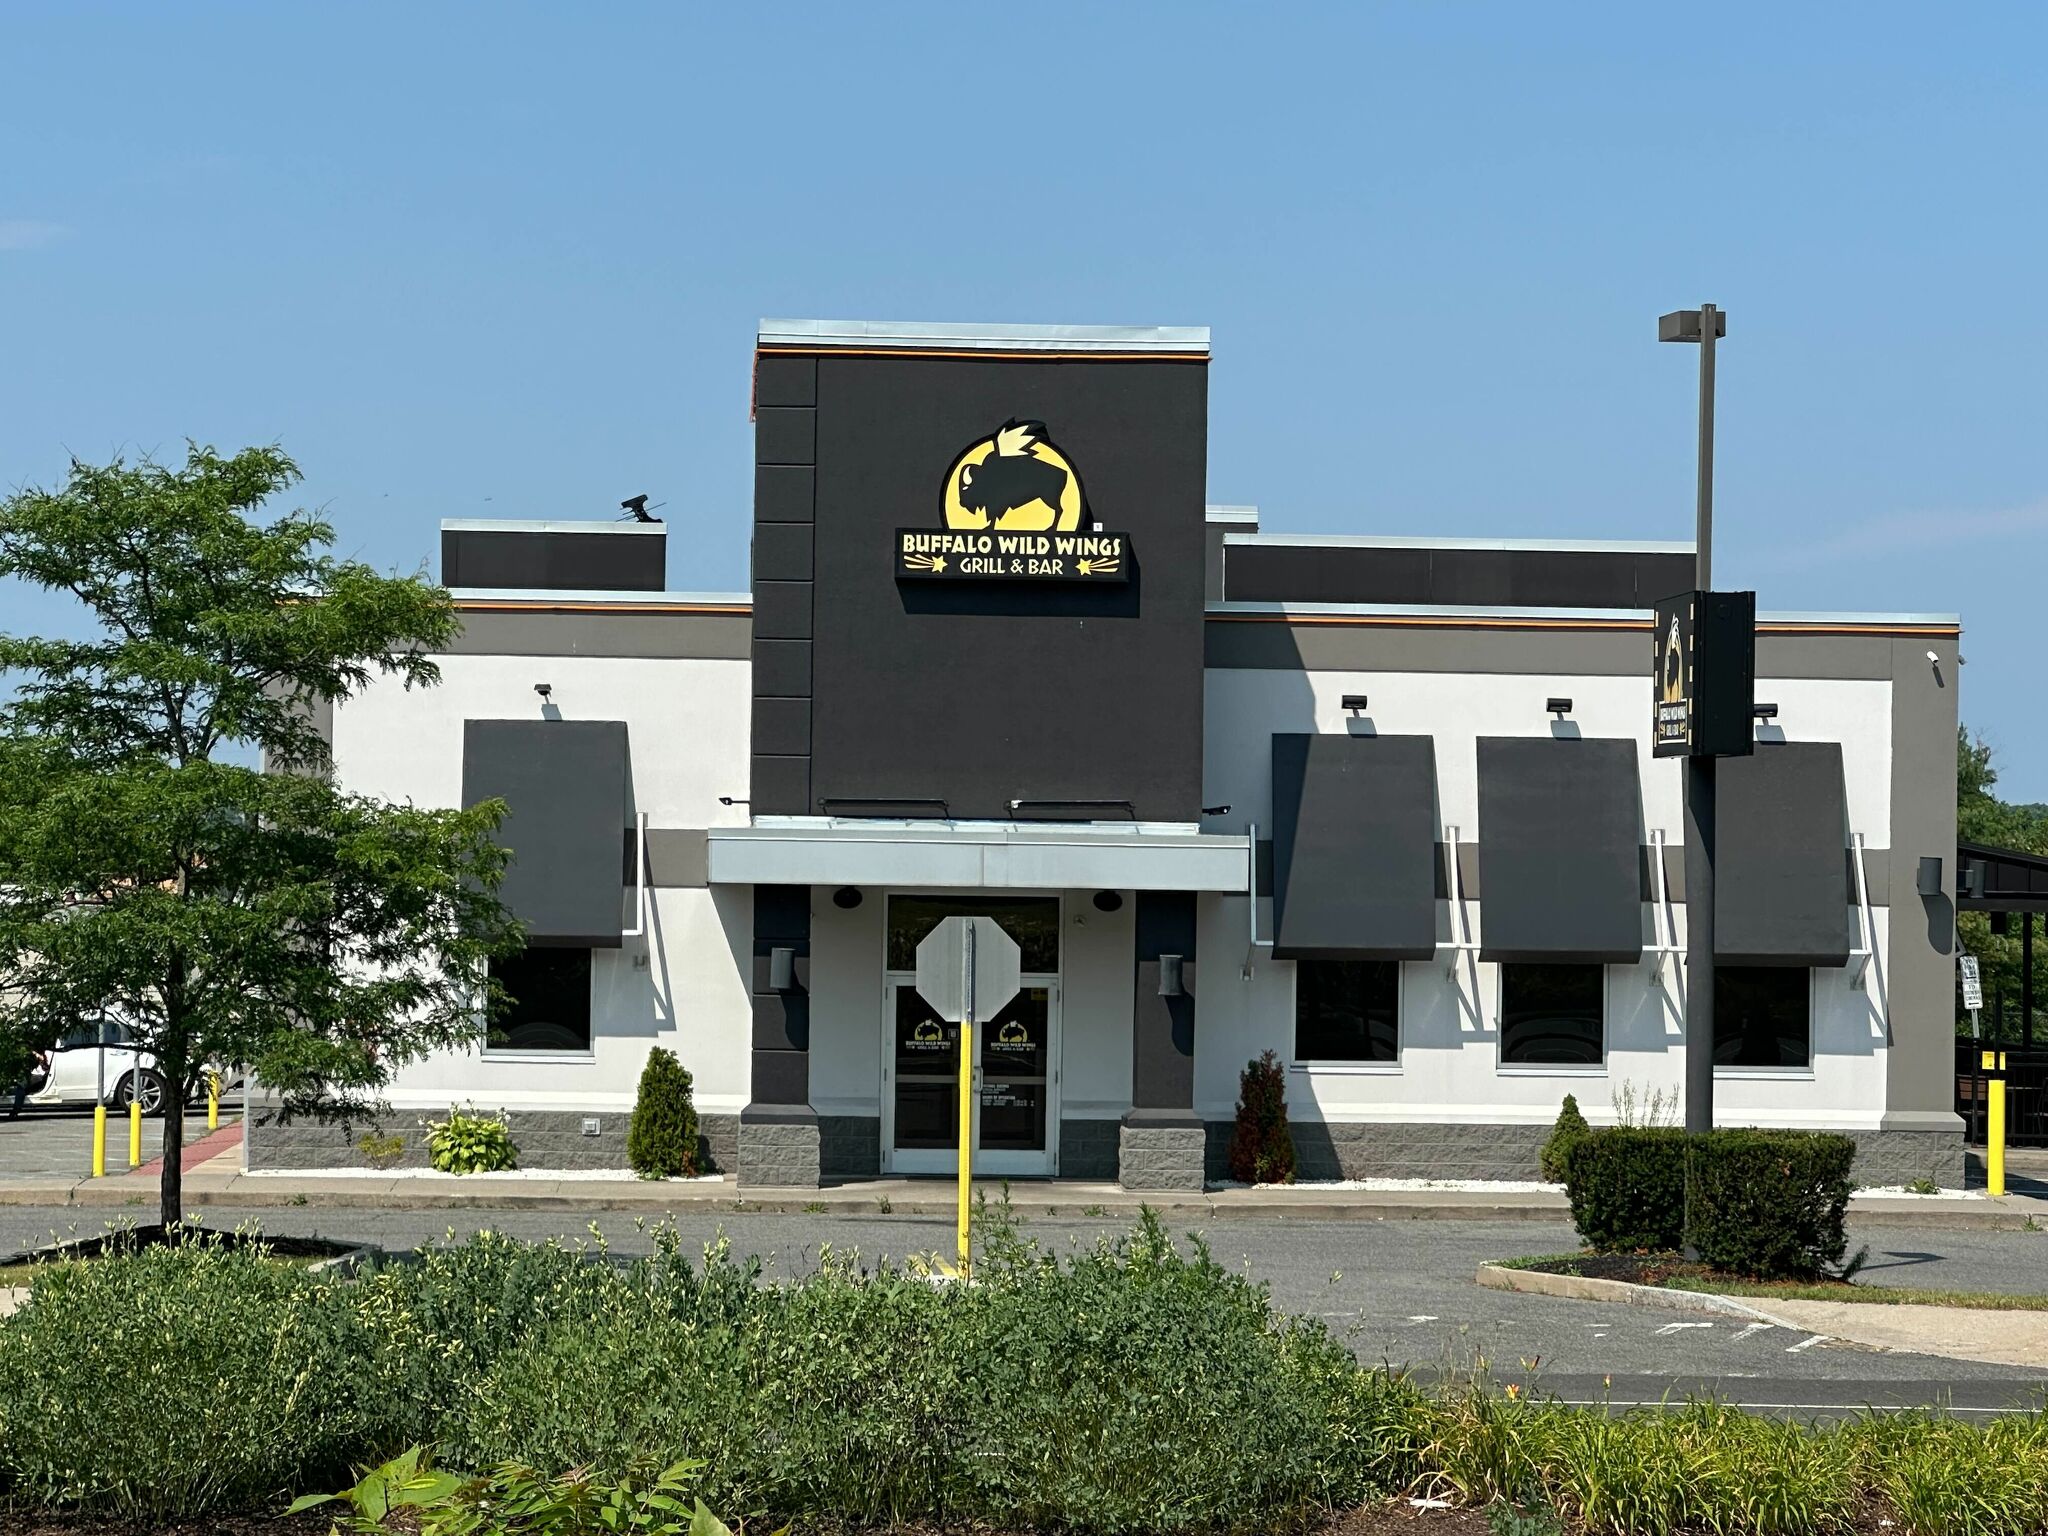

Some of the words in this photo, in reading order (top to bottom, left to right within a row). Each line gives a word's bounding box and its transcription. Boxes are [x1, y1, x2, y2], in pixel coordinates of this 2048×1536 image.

[903, 534, 992, 554] BUFFALO
[998, 536, 1050, 555] WILD
[1055, 537, 1121, 556] WINGS
[960, 557, 1006, 575] GRILL
[1010, 559, 1024, 574] &
[1028, 559, 1064, 575] BAR
